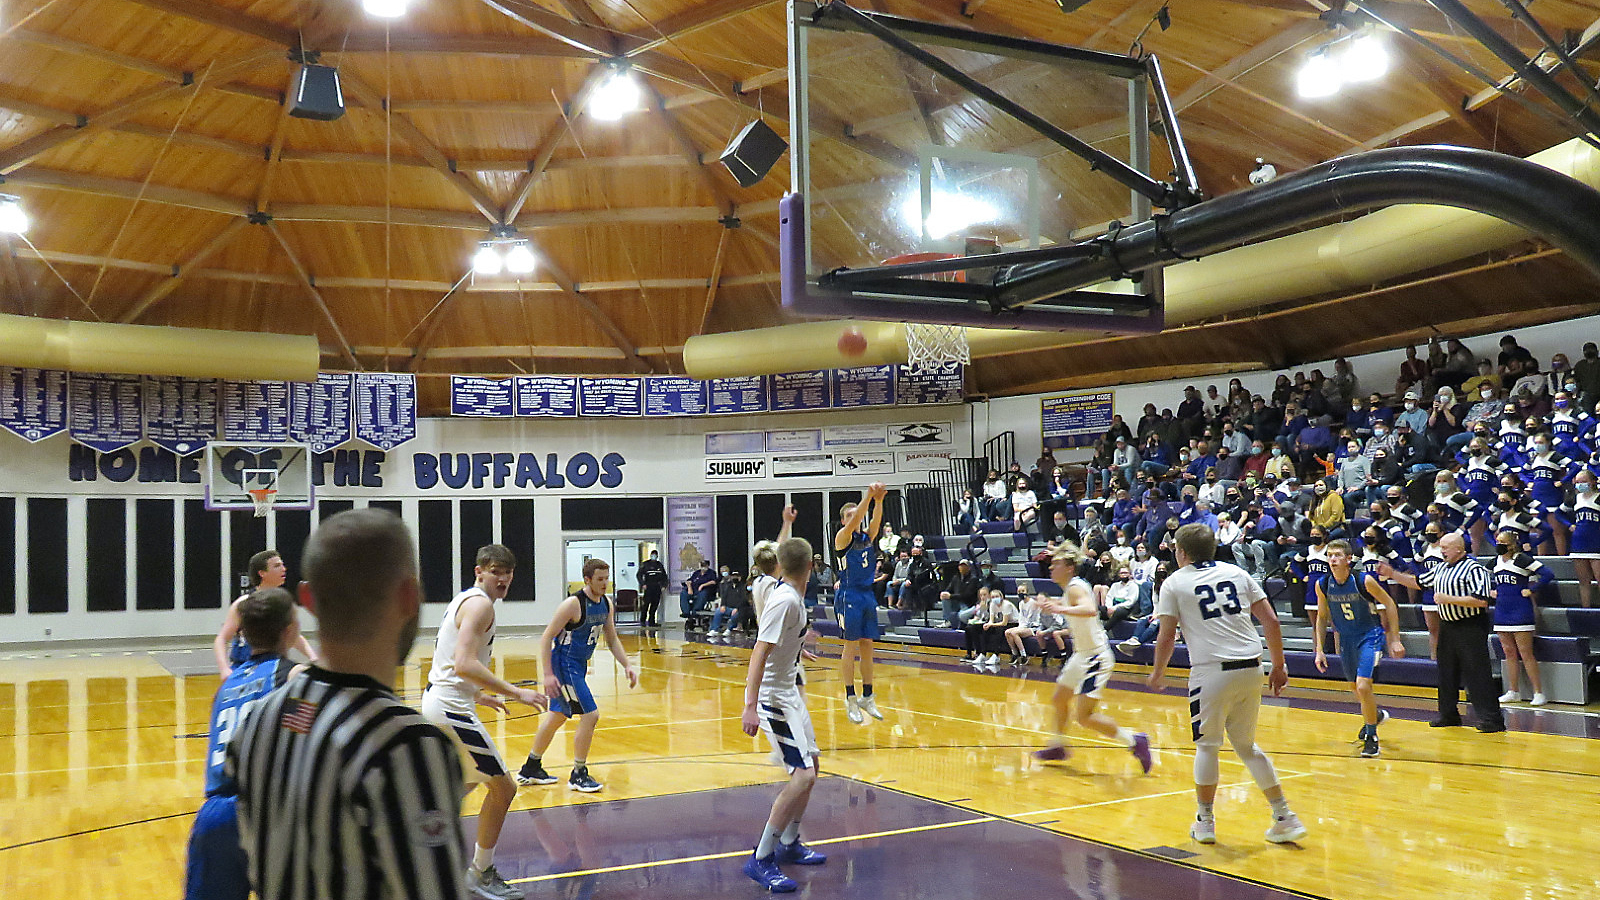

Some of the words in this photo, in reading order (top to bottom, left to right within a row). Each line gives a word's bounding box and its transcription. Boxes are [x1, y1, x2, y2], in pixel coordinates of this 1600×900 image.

[1064, 395, 1095, 403] CITIZENSHIP
[1097, 393, 1111, 401] CODE
[69, 443, 203, 484] HOME
[221, 449, 282, 485] OF
[308, 449, 385, 488] THE
[413, 452, 626, 489] BUFFALOS
[706, 461, 764, 476] SUBWAY
[861, 551, 869, 569] 3
[1194, 580, 1242, 620] 23
[1340, 603, 1355, 620] 5
